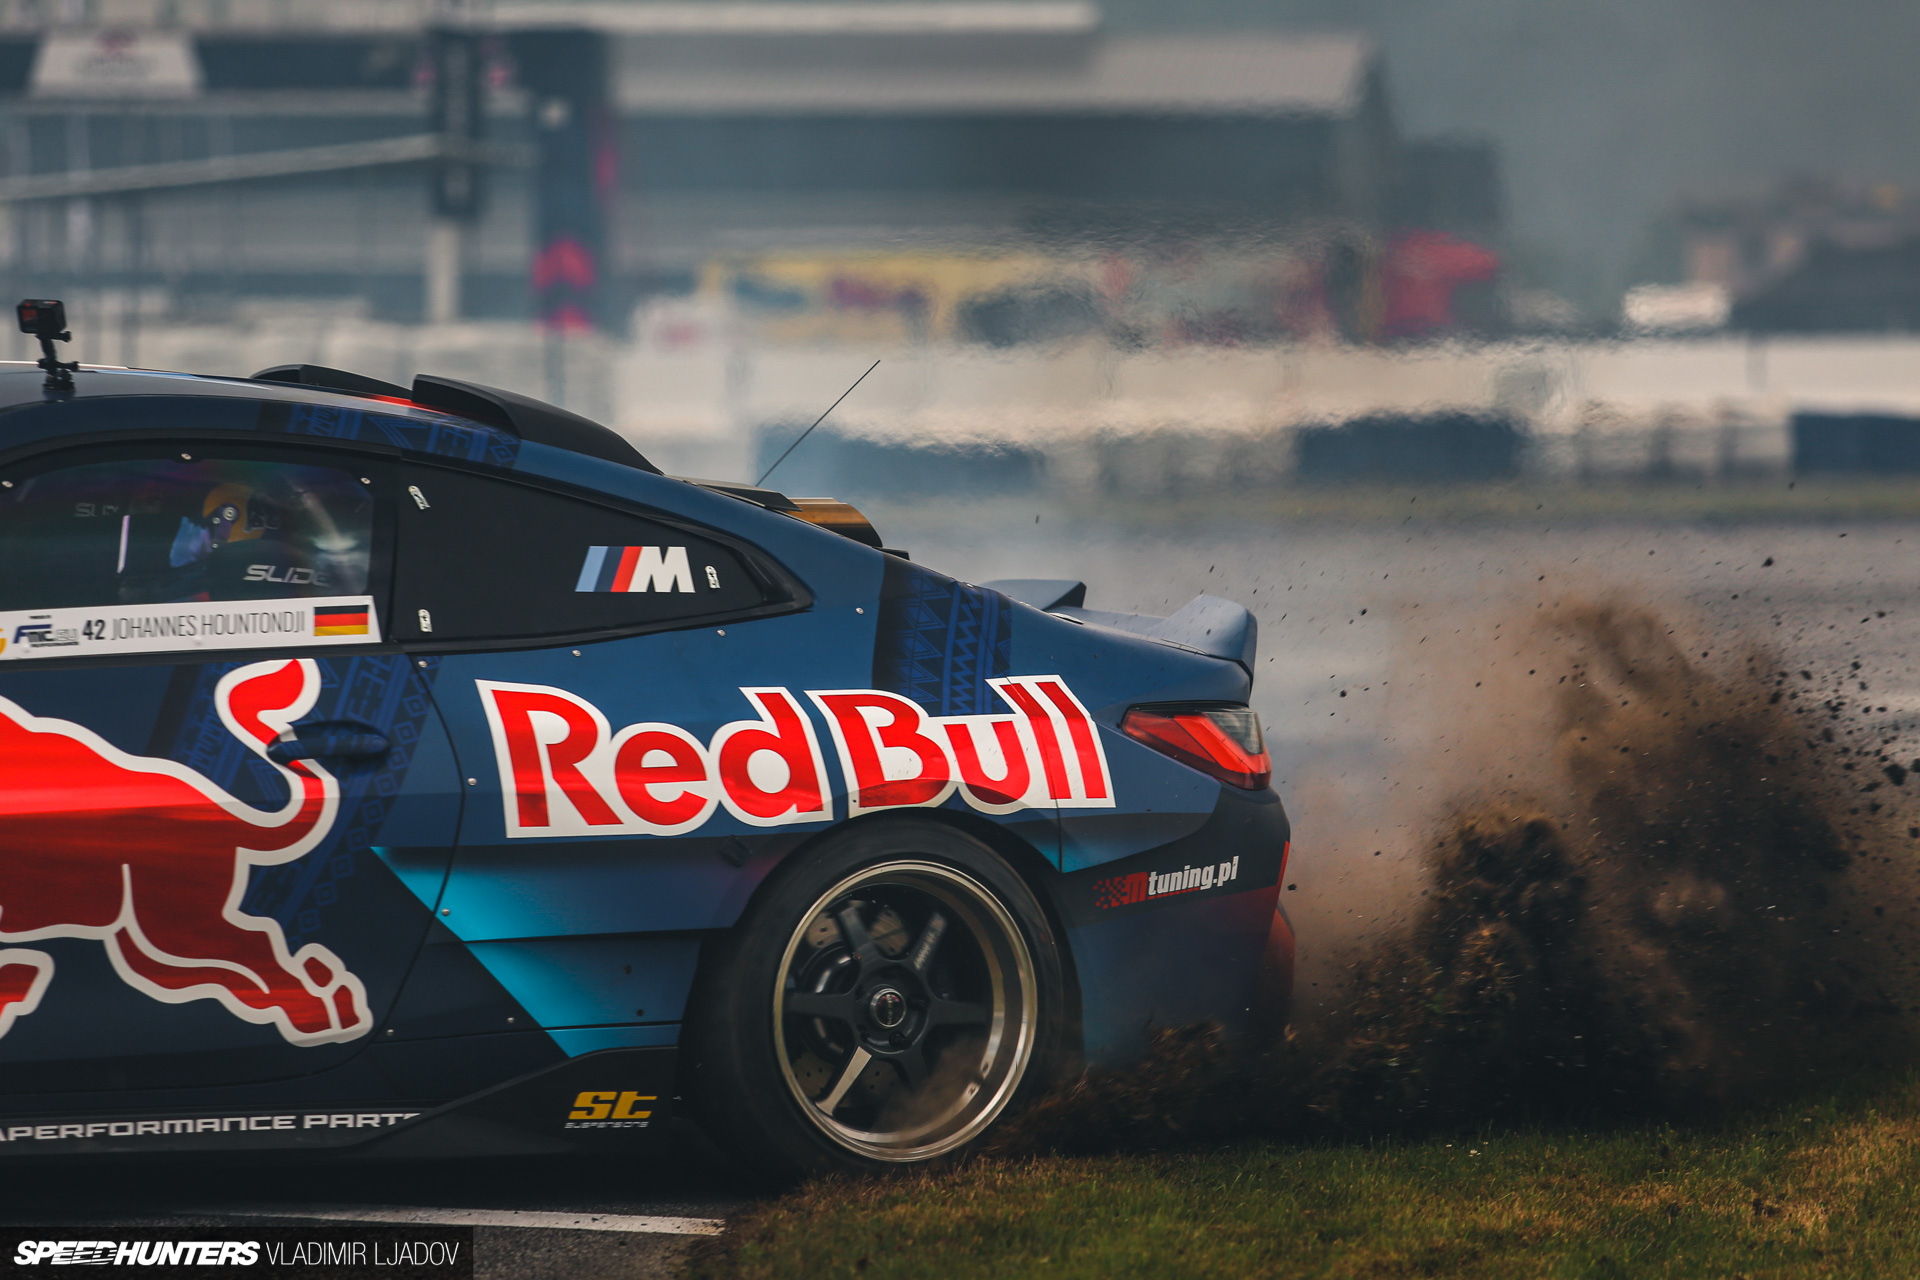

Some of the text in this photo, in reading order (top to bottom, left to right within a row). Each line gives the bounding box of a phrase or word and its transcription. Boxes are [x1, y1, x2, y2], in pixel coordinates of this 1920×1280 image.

[82, 610, 305, 641] 42 JOHANNES HOUNTONDJI
